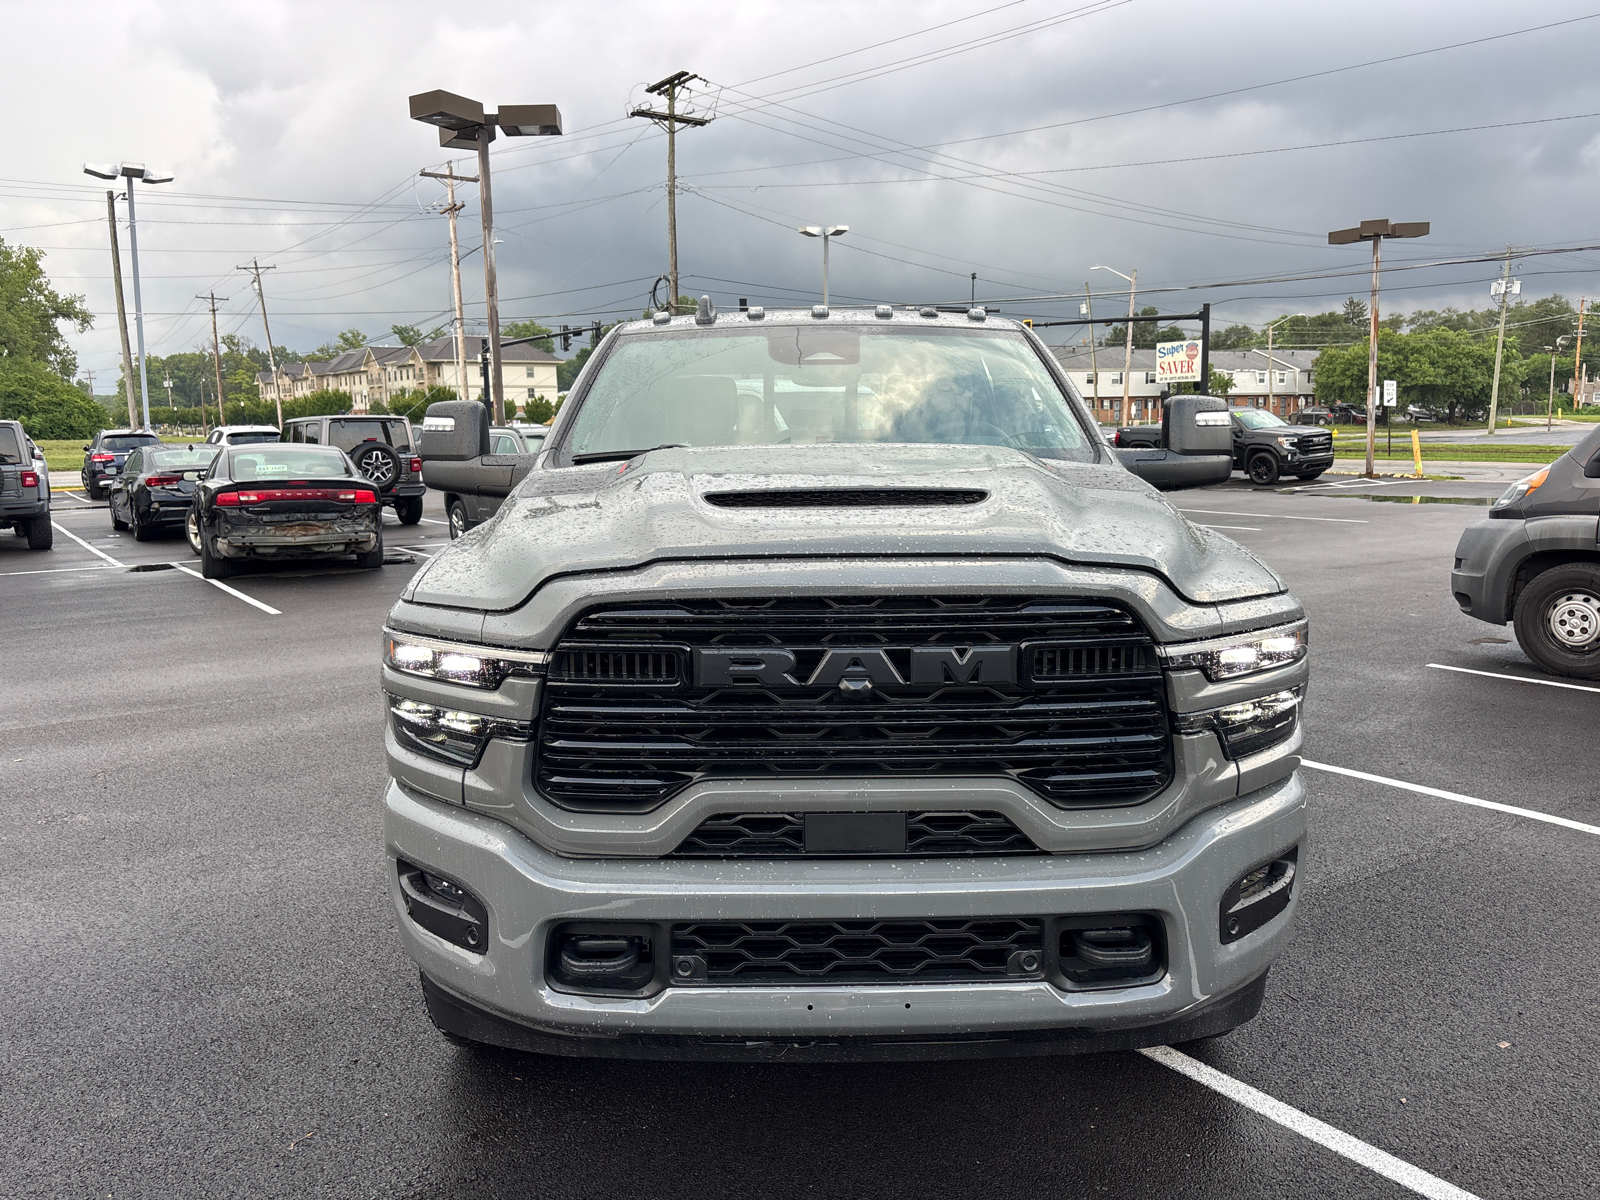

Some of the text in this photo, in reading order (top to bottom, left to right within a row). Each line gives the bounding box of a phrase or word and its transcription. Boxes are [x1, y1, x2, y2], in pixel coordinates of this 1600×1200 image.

[1158, 343, 1184, 358] Super
[1159, 359, 1194, 375] SAVER
[699, 645, 1015, 686] RAM
